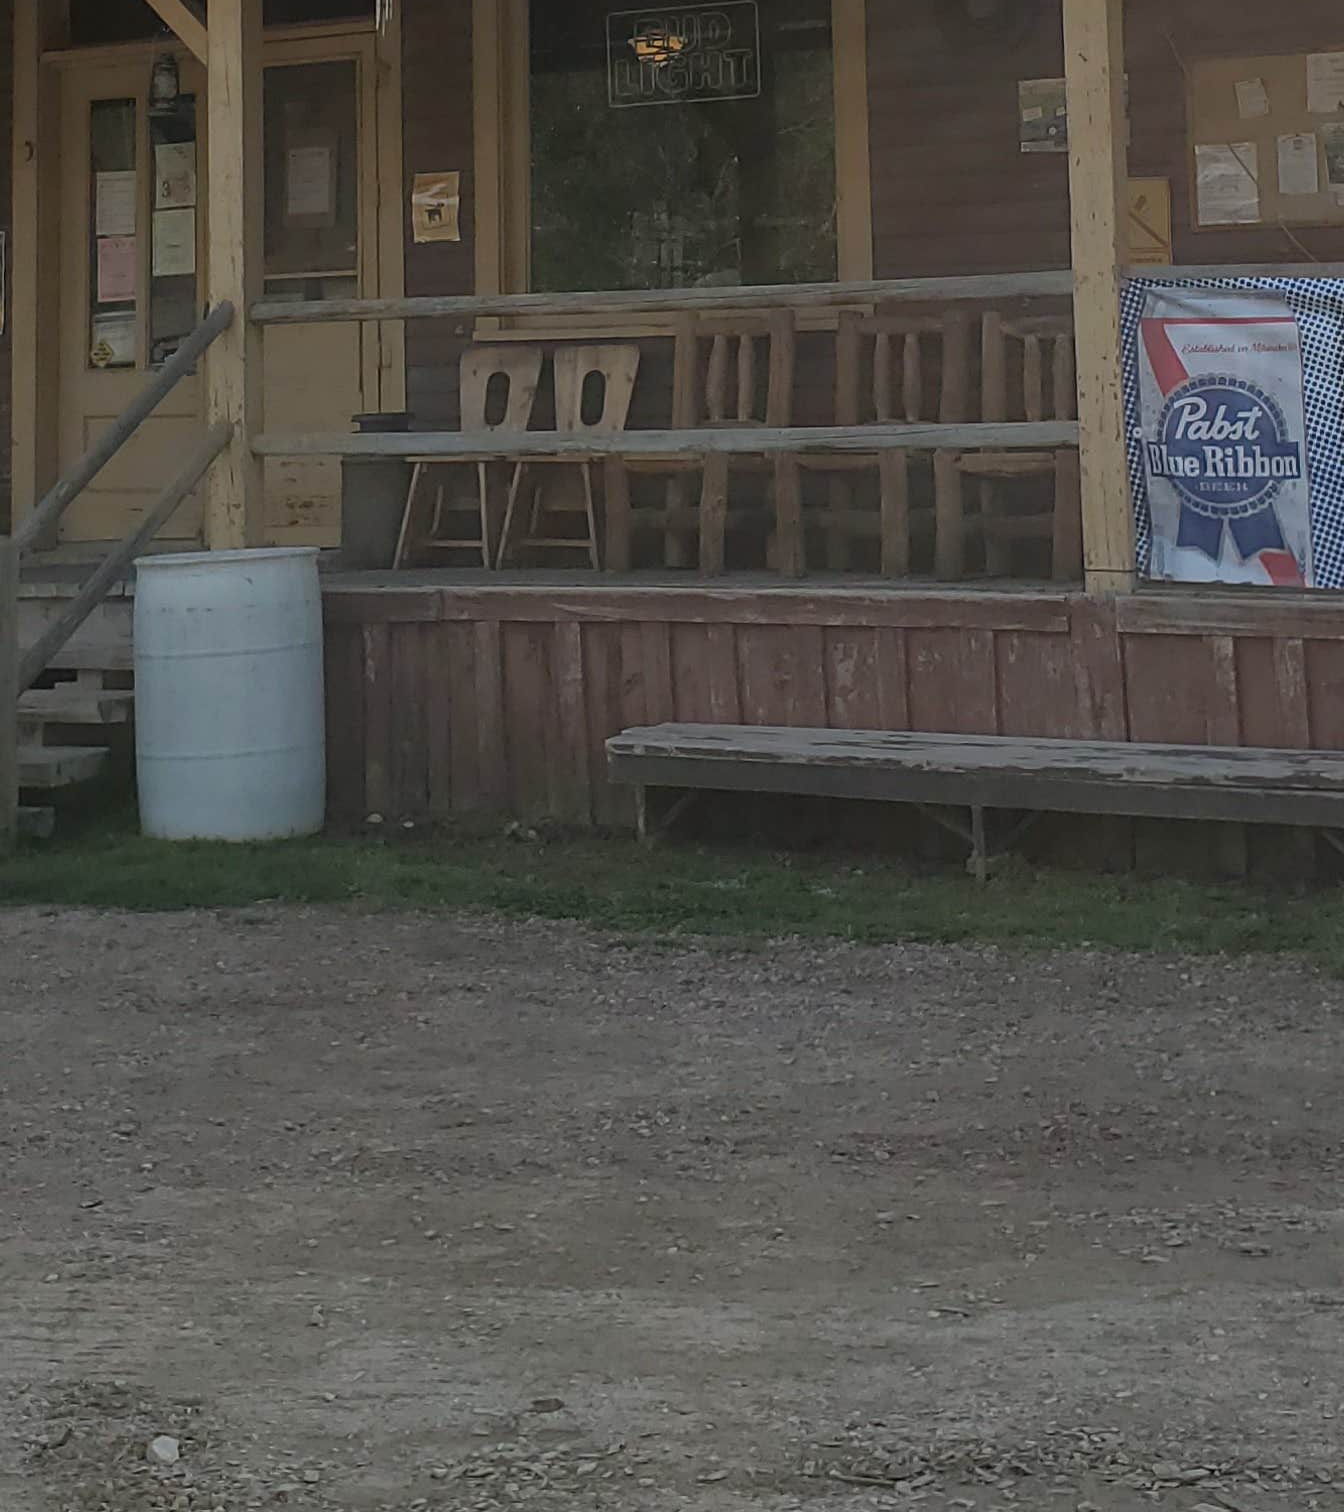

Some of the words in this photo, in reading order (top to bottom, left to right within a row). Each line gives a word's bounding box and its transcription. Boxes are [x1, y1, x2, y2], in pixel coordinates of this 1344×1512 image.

[614, 49, 752, 97] LIGHT
[1173, 396, 1263, 441] Pabst
[1147, 443, 1200, 477] Blue
[1202, 445, 1299, 478] Ribbon
